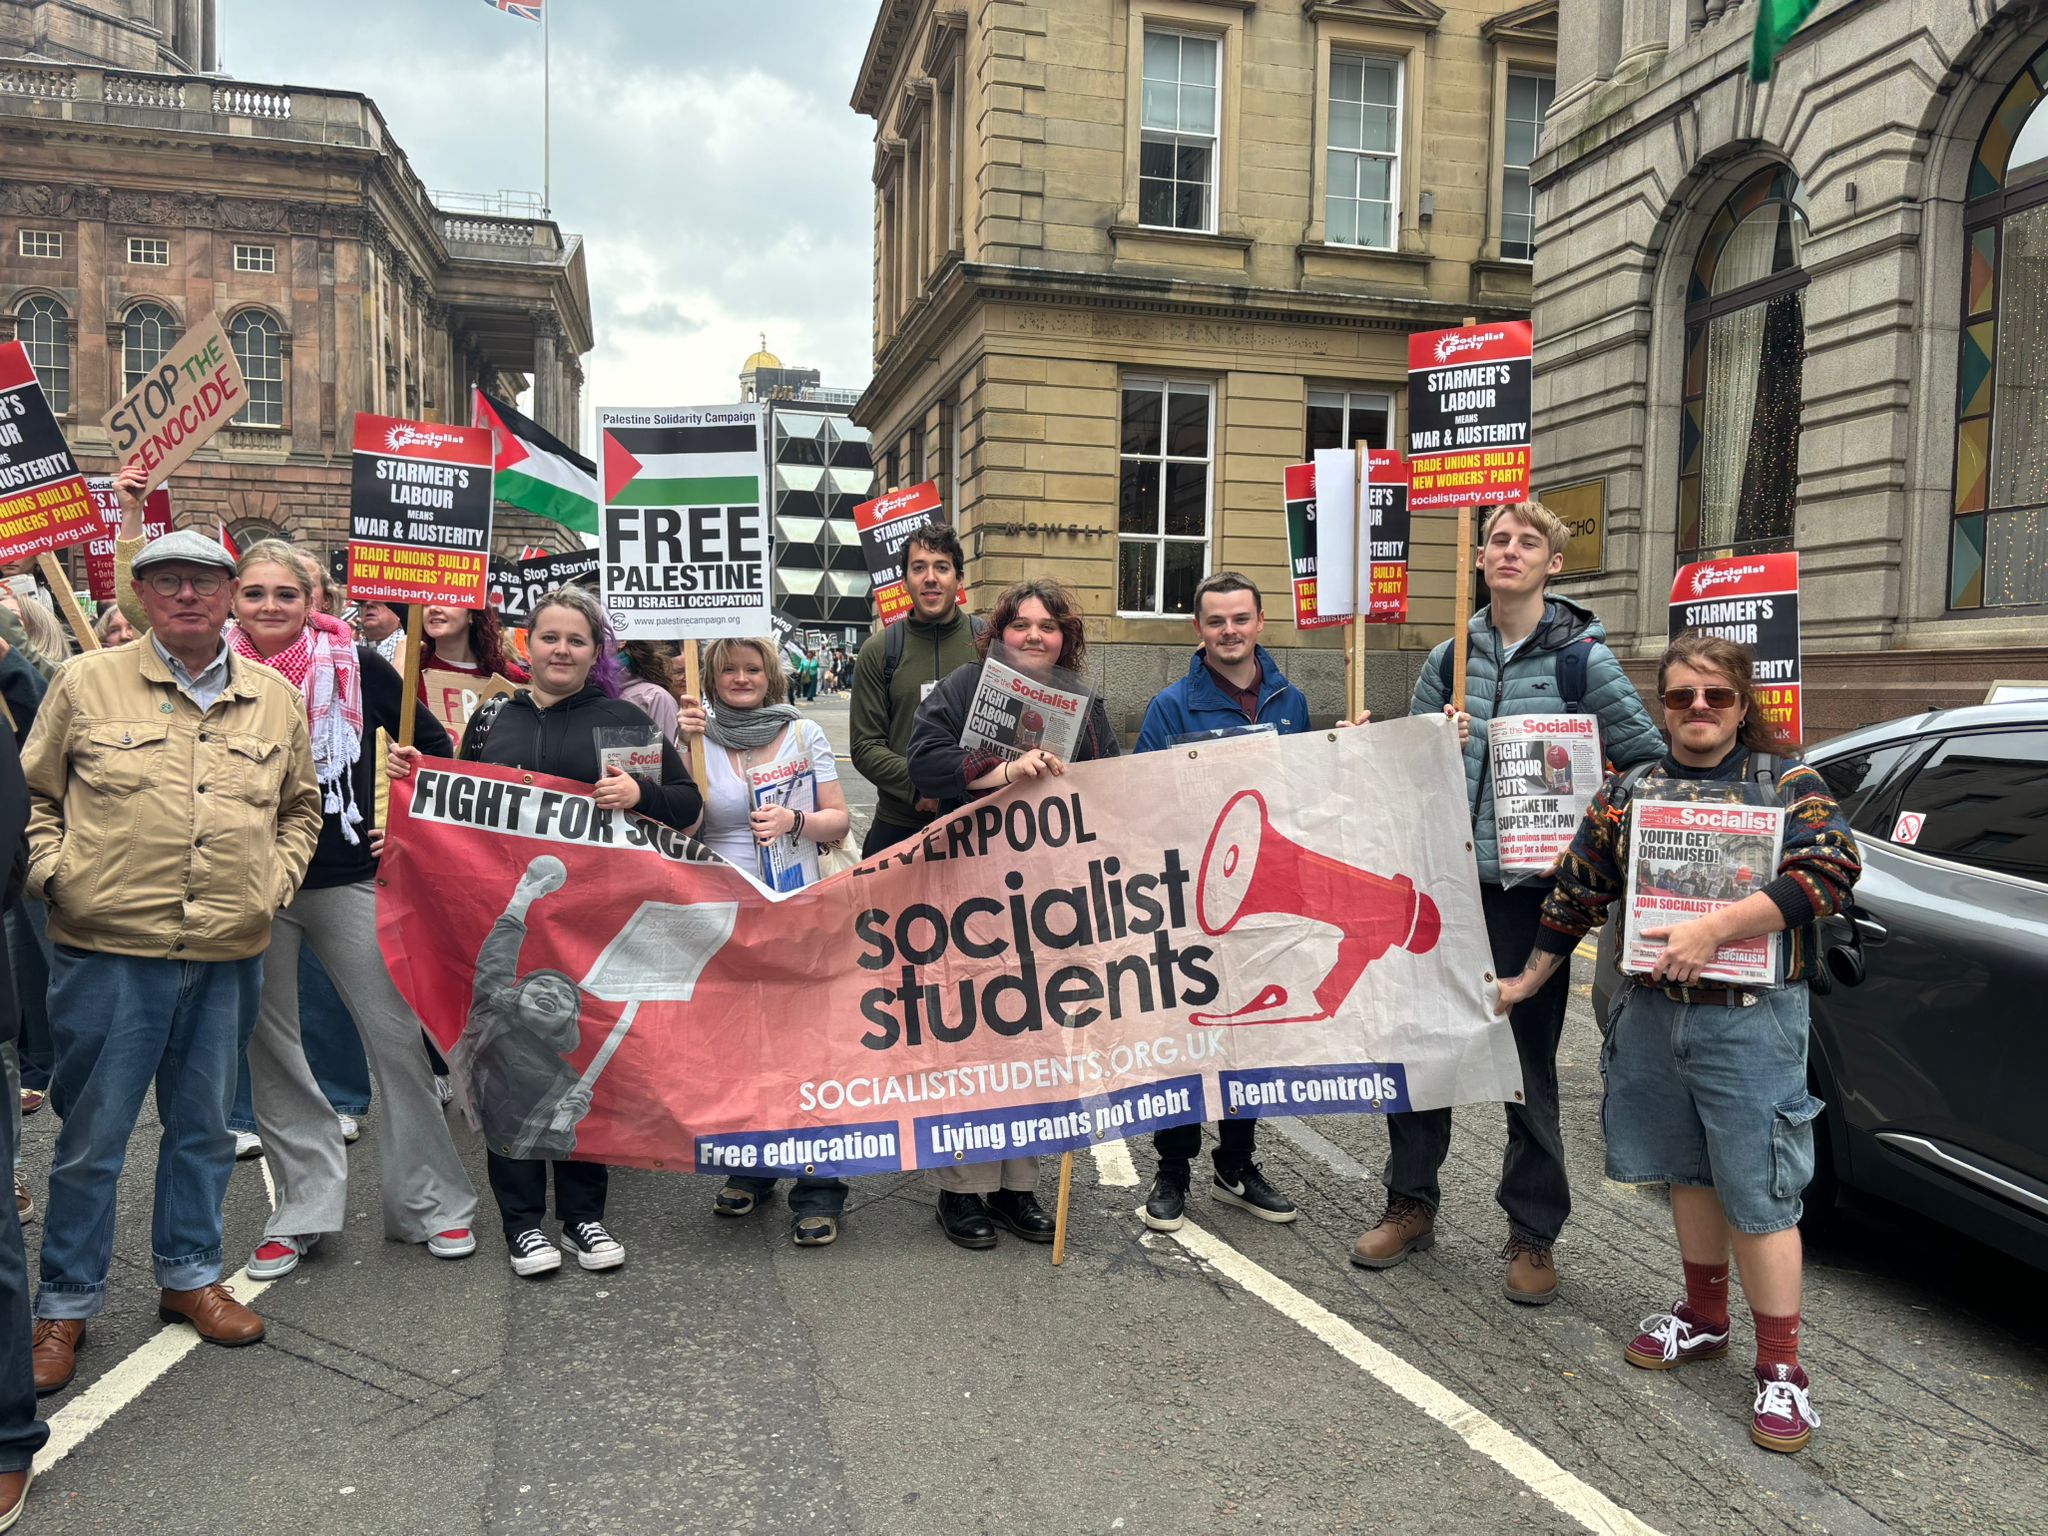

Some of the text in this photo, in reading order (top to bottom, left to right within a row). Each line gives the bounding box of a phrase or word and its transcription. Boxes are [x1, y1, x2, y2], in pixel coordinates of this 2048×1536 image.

[1446, 341, 1483, 356] Party
[1450, 332, 1505, 346] Socialist
[1427, 365, 1511, 392] STARMER'S
[110, 335, 225, 451] STOP THE
[1440, 389, 1496, 413] LABOUR
[603, 411, 756, 425] Palestine Solidarity Campaign
[1455, 413, 1478, 424] MEANS
[399, 435, 444, 449] Party
[405, 427, 464, 445] Socialist
[1411, 423, 1527, 449] WAR & AUSTERITY
[1412, 451, 1525, 473] TRADE UNIONS BUILD A
[376, 460, 469, 489] STARMER'S
[1412, 468, 1524, 490] NEW WORKERS' PARTY
[0, 495, 37, 520] NIONS
[36, 485, 73, 508] BUILD
[74, 482, 85, 498] A
[390, 484, 453, 509] LABOUR
[1411, 488, 1521, 506] socialistparty.org.uk
[0, 512, 50, 541] ORKERS'
[51, 500, 91, 524] PARTY
[407, 509, 434, 521] MEANS
[354, 517, 484, 547] WAR & AUSTERITY
[605, 506, 762, 564] FREE
[1566, 518, 1596, 538] CHO
[354, 546, 480, 571] TRADE UNIONS BUILD A
[353, 563, 380, 579] NEW
[383, 566, 441, 584] WORKERS'
[444, 571, 479, 588] PARTY
[524, 567, 548, 581] Stop
[550, 558, 600, 577] Starvin
[607, 563, 763, 591] PALESTINE
[872, 567, 895, 585] WAR
[1373, 566, 1402, 579] BUILD A
[1706, 565, 1765, 578] Socialist
[1378, 581, 1402, 594] PARTY
[1702, 574, 1742, 588] Party
[351, 585, 475, 604] socialistparty.org.uk
[610, 594, 761, 608] END ISRAELI OCCUPATION
[878, 586, 900, 601] TRADE
[881, 601, 898, 613] NEW
[1686, 599, 1774, 626] STARMER'S
[634, 615, 741, 627] www.palestinecampaign.org
[980, 685, 1011, 711] FIGHT
[1010, 678, 1079, 712] Socialist
[1784, 689, 1793, 704] A
[975, 700, 1016, 730] LABOUR
[971, 717, 999, 739] CUTS
[1522, 719, 1593, 734] Socialist
[1493, 742, 1528, 762] FIGHT
[753, 758, 809, 786] Socialist
[1494, 759, 1542, 780] LABOUR
[1496, 777, 1528, 797] CUTS
[412, 771, 531, 831] FIGHT
[536, 794, 615, 844] FOR
[1511, 799, 1559, 814] MAKE THE
[1498, 814, 1575, 831] SUPER-RICH PAY
[1664, 815, 1679, 825] the
[1679, 808, 1776, 831] Socialist
[1517, 832, 1540, 842] unions
[1541, 832, 1557, 842] must
[1640, 830, 1685, 846] YOUTH
[1686, 832, 1710, 847] GET
[1510, 845, 1524, 855] day
[1524, 843, 1534, 853] for
[1540, 843, 1558, 853] demo
[1639, 845, 1720, 863] ORGANISED!
[856, 849, 1189, 971] socialist
[1635, 897, 1657, 909] JOIN
[1659, 898, 1714, 914] SOCIALIST
[1718, 951, 1765, 964] SOCIALISM
[860, 930, 1220, 1051] students
[799, 1030, 1229, 1111] SOCIALISTSTUDENTS.ORG.UK
[1228, 1071, 1397, 1107] Rent controls
[931, 1087, 1192, 1154] Living grants not debt
[700, 1131, 896, 1168] Free education
